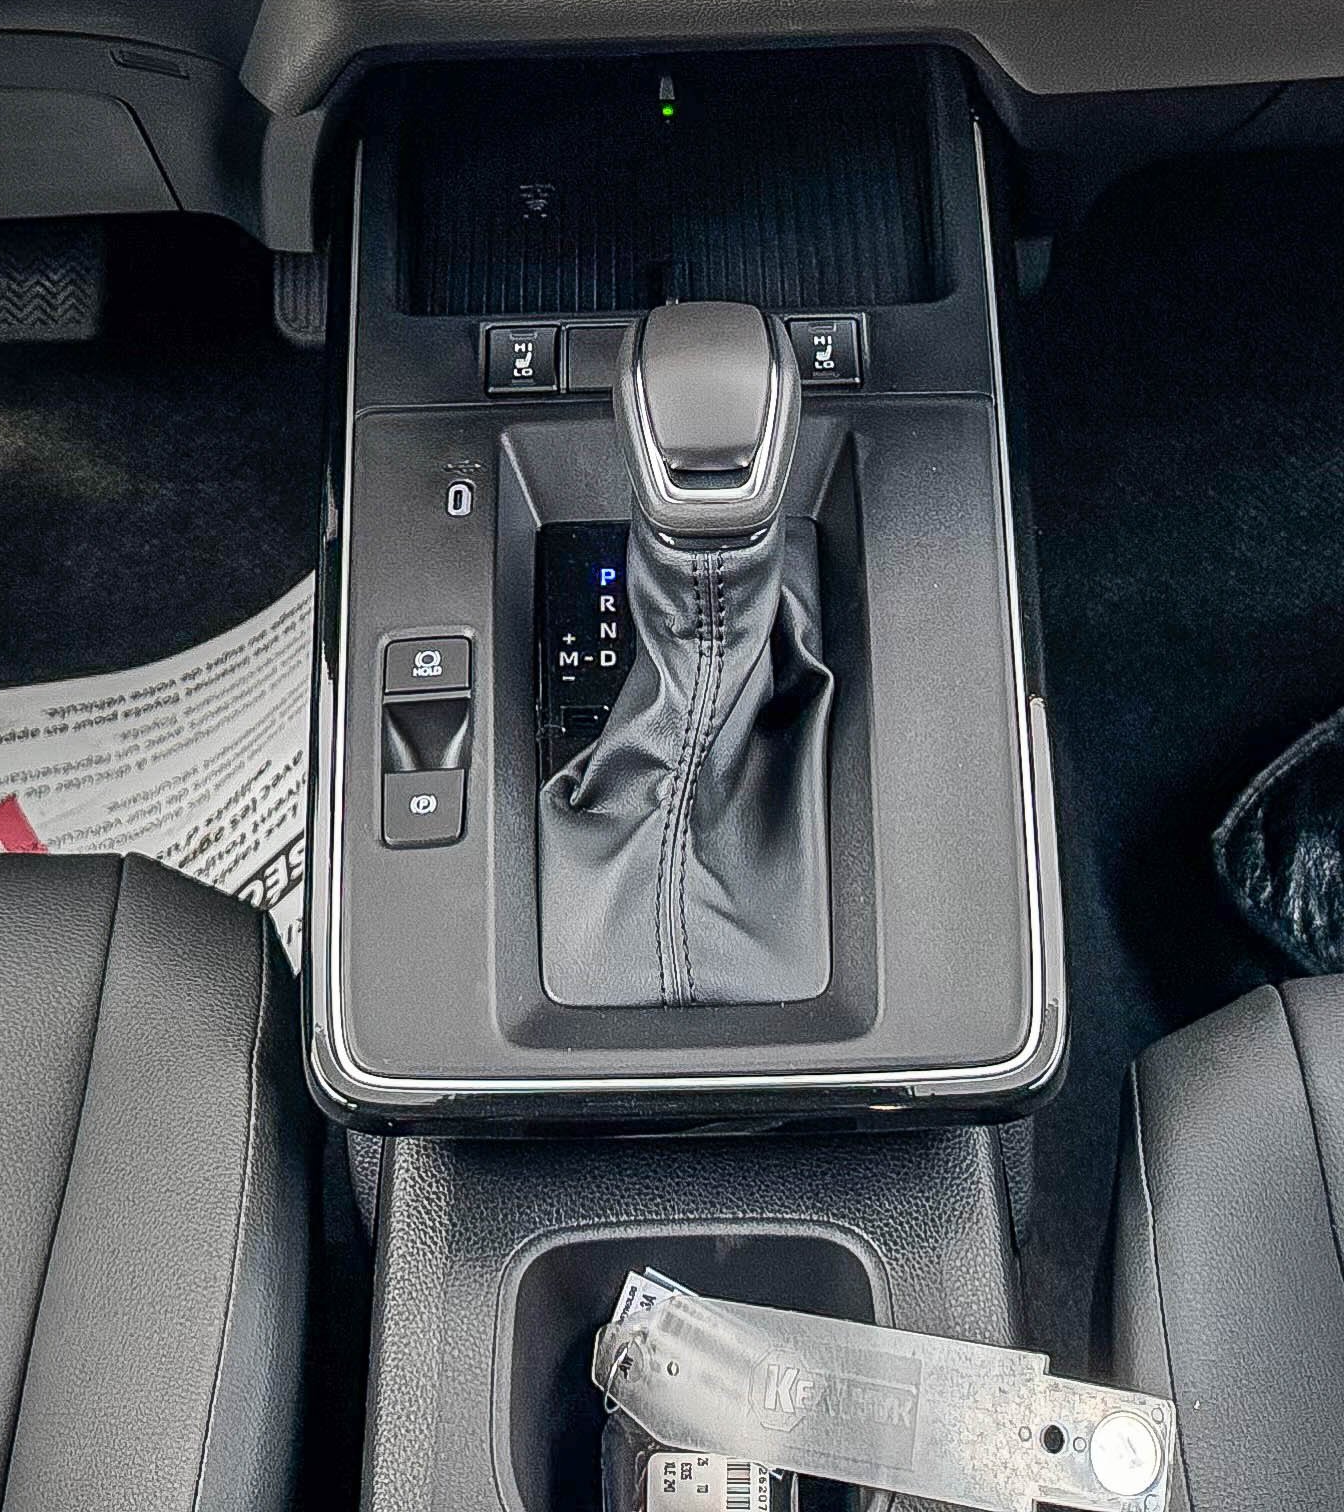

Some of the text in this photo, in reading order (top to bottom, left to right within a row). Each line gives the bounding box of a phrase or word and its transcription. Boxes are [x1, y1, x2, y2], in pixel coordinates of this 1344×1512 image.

[812, 335, 833, 346] HI
[513, 342, 534, 353] HI
[814, 360, 835, 371] LO
[513, 367, 534, 377] LO
[600, 568, 616, 586] P
[600, 595, 616, 613] R
[600, 621, 617, 639] N
[559, 650, 617, 667] M D
[413, 666, 442, 676] HOLD
